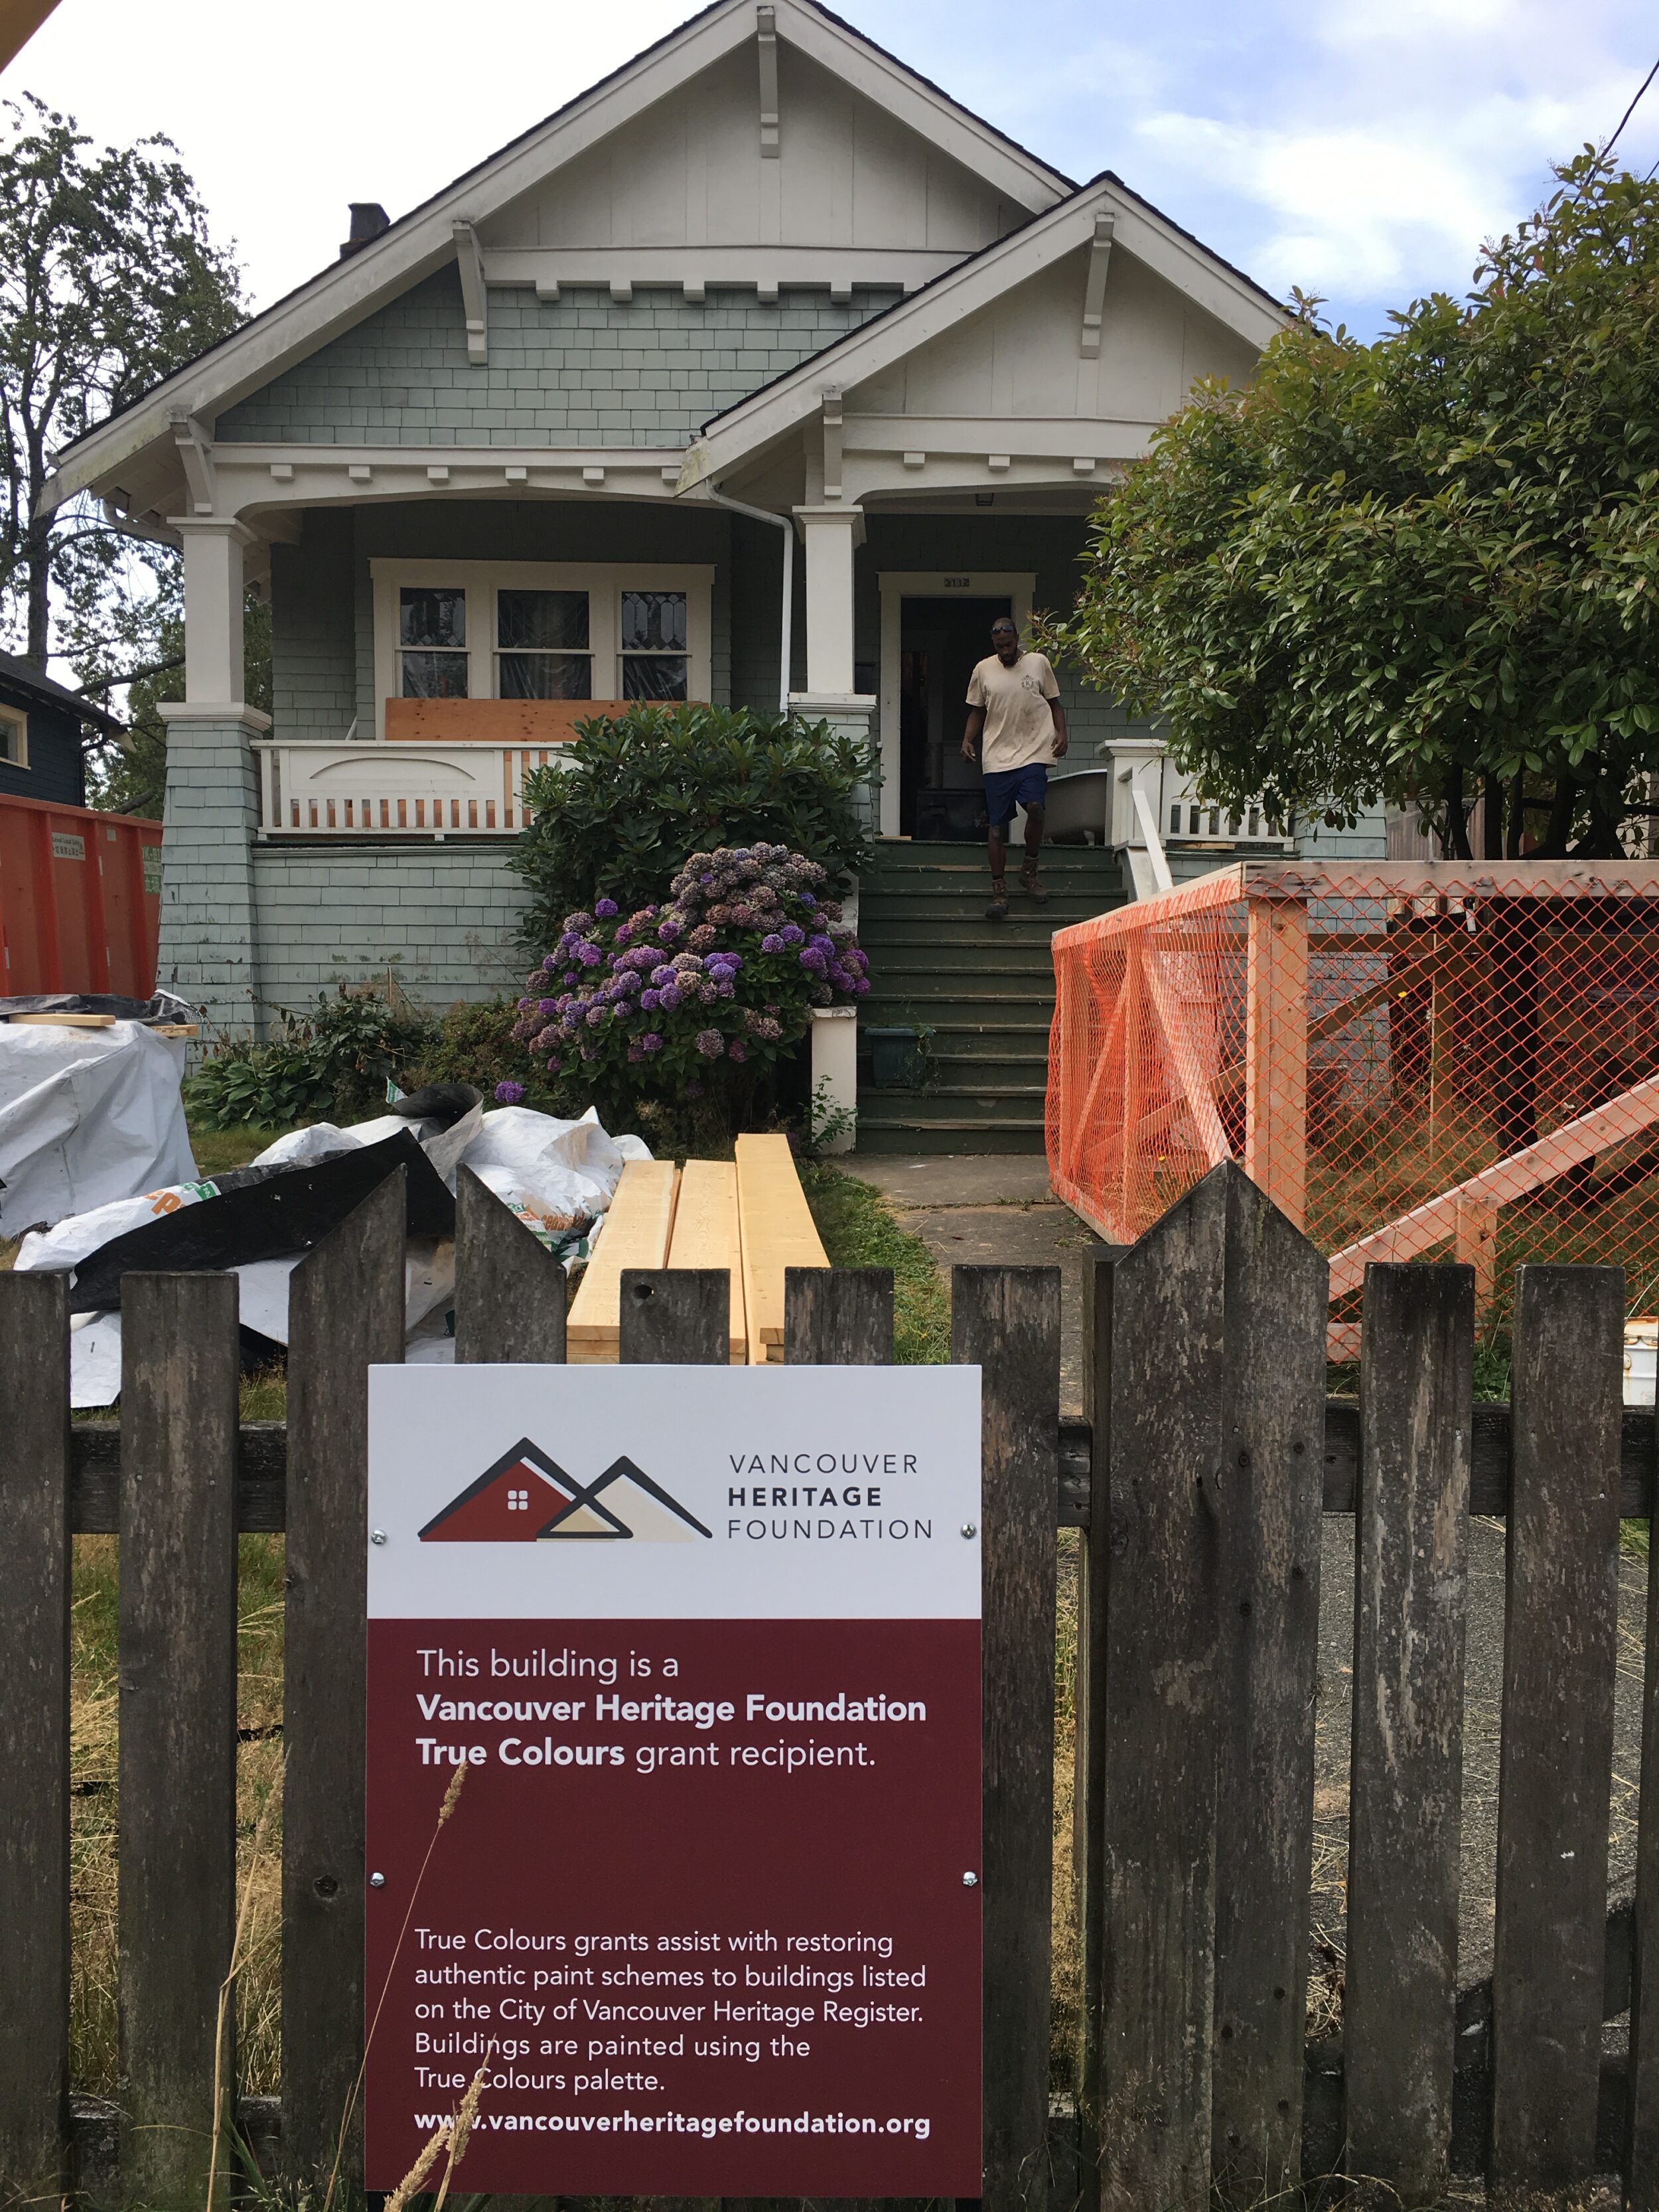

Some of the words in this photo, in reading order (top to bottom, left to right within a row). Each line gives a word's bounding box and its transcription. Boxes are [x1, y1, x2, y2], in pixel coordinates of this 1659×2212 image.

[729, 1453, 918, 1474] VANCOUVER
[729, 1487, 881, 1507] HERITAGE
[728, 1519, 932, 1540] FOUNDATION
[417, 1649, 480, 1678] This
[492, 1649, 618, 1685] building
[630, 1651, 652, 1678] is
[663, 1659, 679, 1678] a
[417, 1694, 587, 1722] Vancouver
[596, 1694, 735, 1730] Heritage
[747, 1693, 926, 1722] Foundation
[415, 1737, 488, 1766] True
[499, 1737, 625, 1766] Colours
[635, 1743, 719, 1772] grant
[731, 1739, 876, 1773] recipient.
[415, 1929, 466, 1951] True
[475, 1929, 567, 1951] Colours
[575, 1933, 650, 1957] grants
[658, 1931, 721, 1952] assist
[729, 1930, 778, 1952] with
[788, 1931, 893, 1958] restoring
[415, 1963, 526, 1986] authentic
[535, 1965, 595, 1992] paint
[603, 1964, 704, 1987] schemes
[712, 1969, 737, 1987] to
[746, 1964, 855, 1993] buildings
[863, 1965, 926, 1988] listed
[415, 2004, 444, 2019] on
[453, 1998, 492, 2020] the
[500, 1999, 545, 2026] City
[553, 1998, 578, 2021] of
[583, 2000, 706, 2022] Vancouver
[715, 2001, 816, 2028] Heritage
[824, 2001, 924, 2029] Register.
[415, 2031, 530, 2061] Buildings
[540, 2041, 579, 2055] are
[589, 2034, 684, 2062] painted
[695, 2036, 760, 2063] using
[770, 2035, 811, 2057] the
[414, 2067, 466, 2089] True
[474, 2067, 567, 2090] Colours
[575, 2069, 666, 2096] palette.
